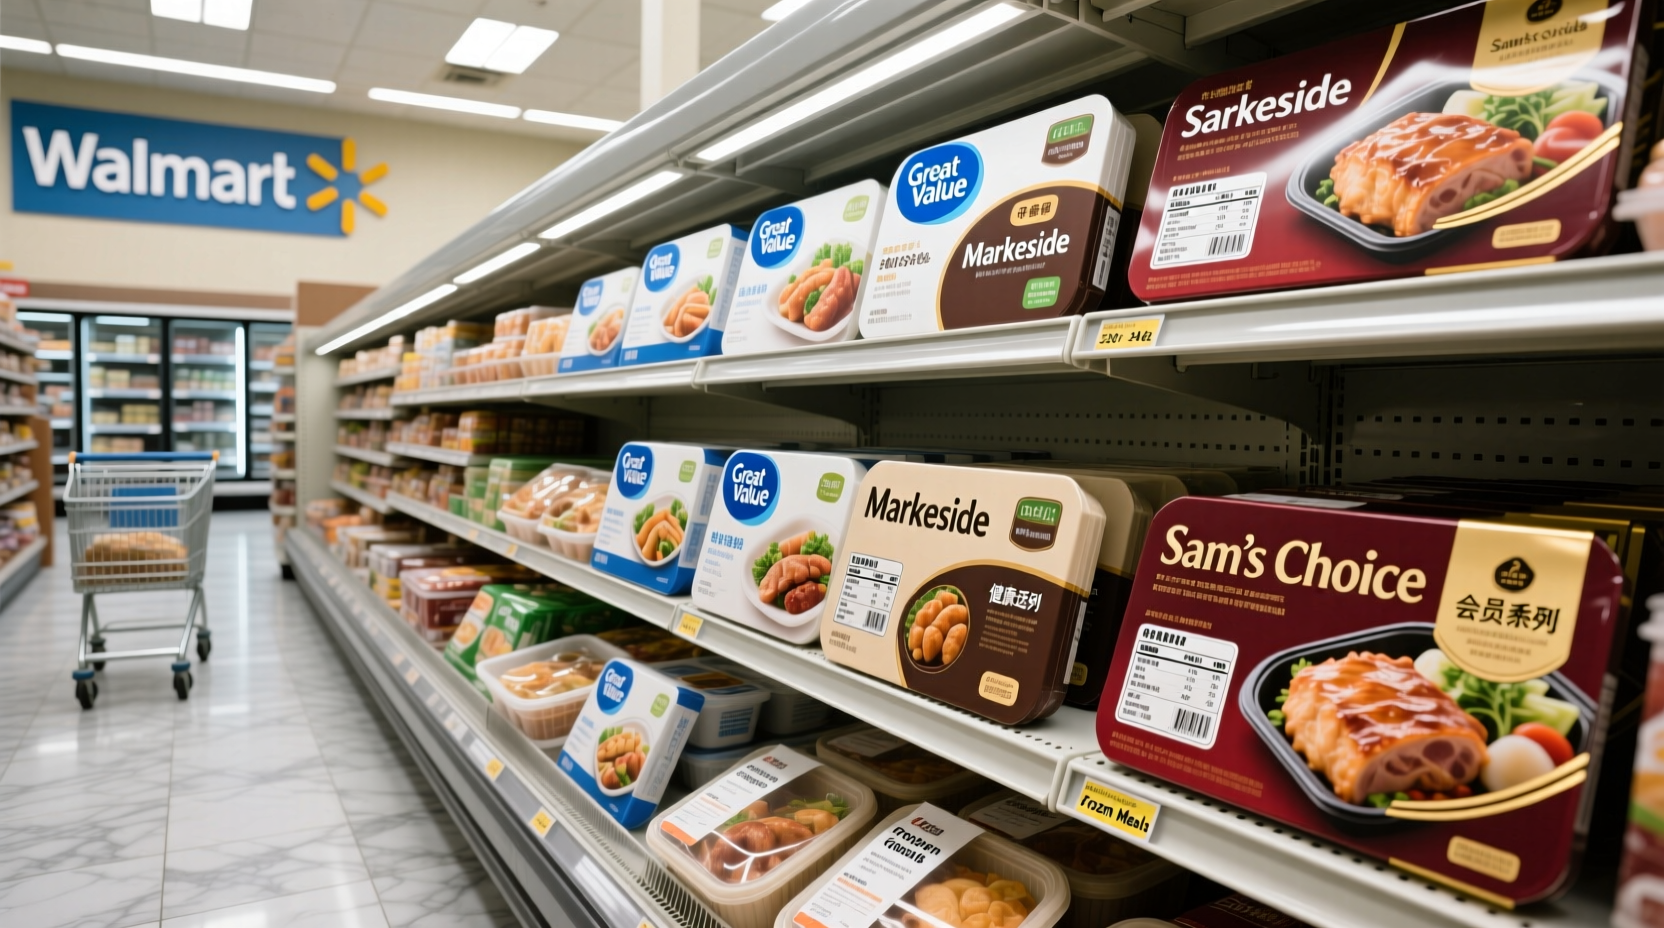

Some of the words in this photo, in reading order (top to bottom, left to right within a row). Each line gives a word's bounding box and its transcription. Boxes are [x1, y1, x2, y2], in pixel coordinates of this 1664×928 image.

[1181, 73, 1352, 138] Sarkeside
[22, 126, 297, 209] Walmart
[907, 155, 961, 187] Great
[912, 176, 968, 207] Value
[759, 216, 793, 240] Great
[761, 230, 796, 255] Value
[961, 228, 1070, 269] Markeside
[732, 463, 766, 486] Great
[733, 482, 769, 507] Value
[864, 486, 990, 537] Markeside
[1160, 524, 1267, 578] Sam's
[1274, 540, 1427, 603] Choice
